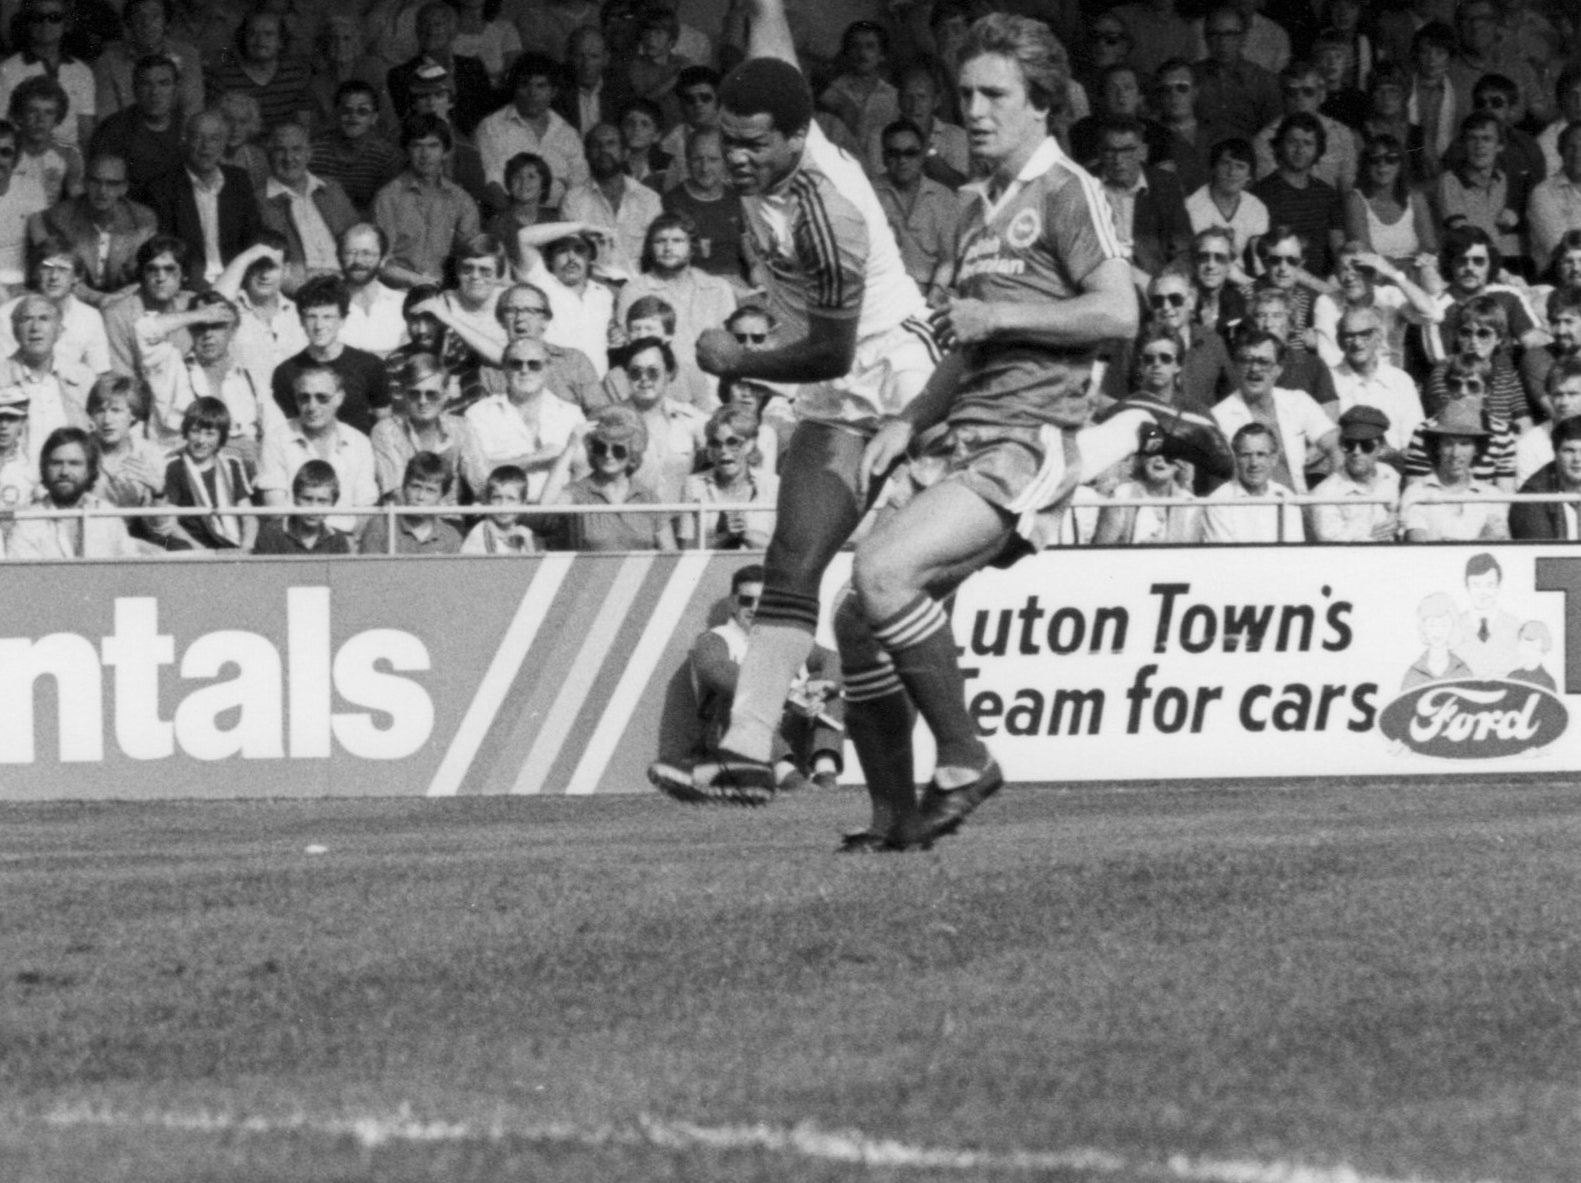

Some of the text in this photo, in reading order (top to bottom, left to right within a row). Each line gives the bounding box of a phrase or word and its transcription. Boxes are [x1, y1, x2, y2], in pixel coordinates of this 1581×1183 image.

[956, 583, 1353, 656] uton Town's
[962, 663, 1378, 737] eam for cars
[1409, 687, 1541, 742] Ford
